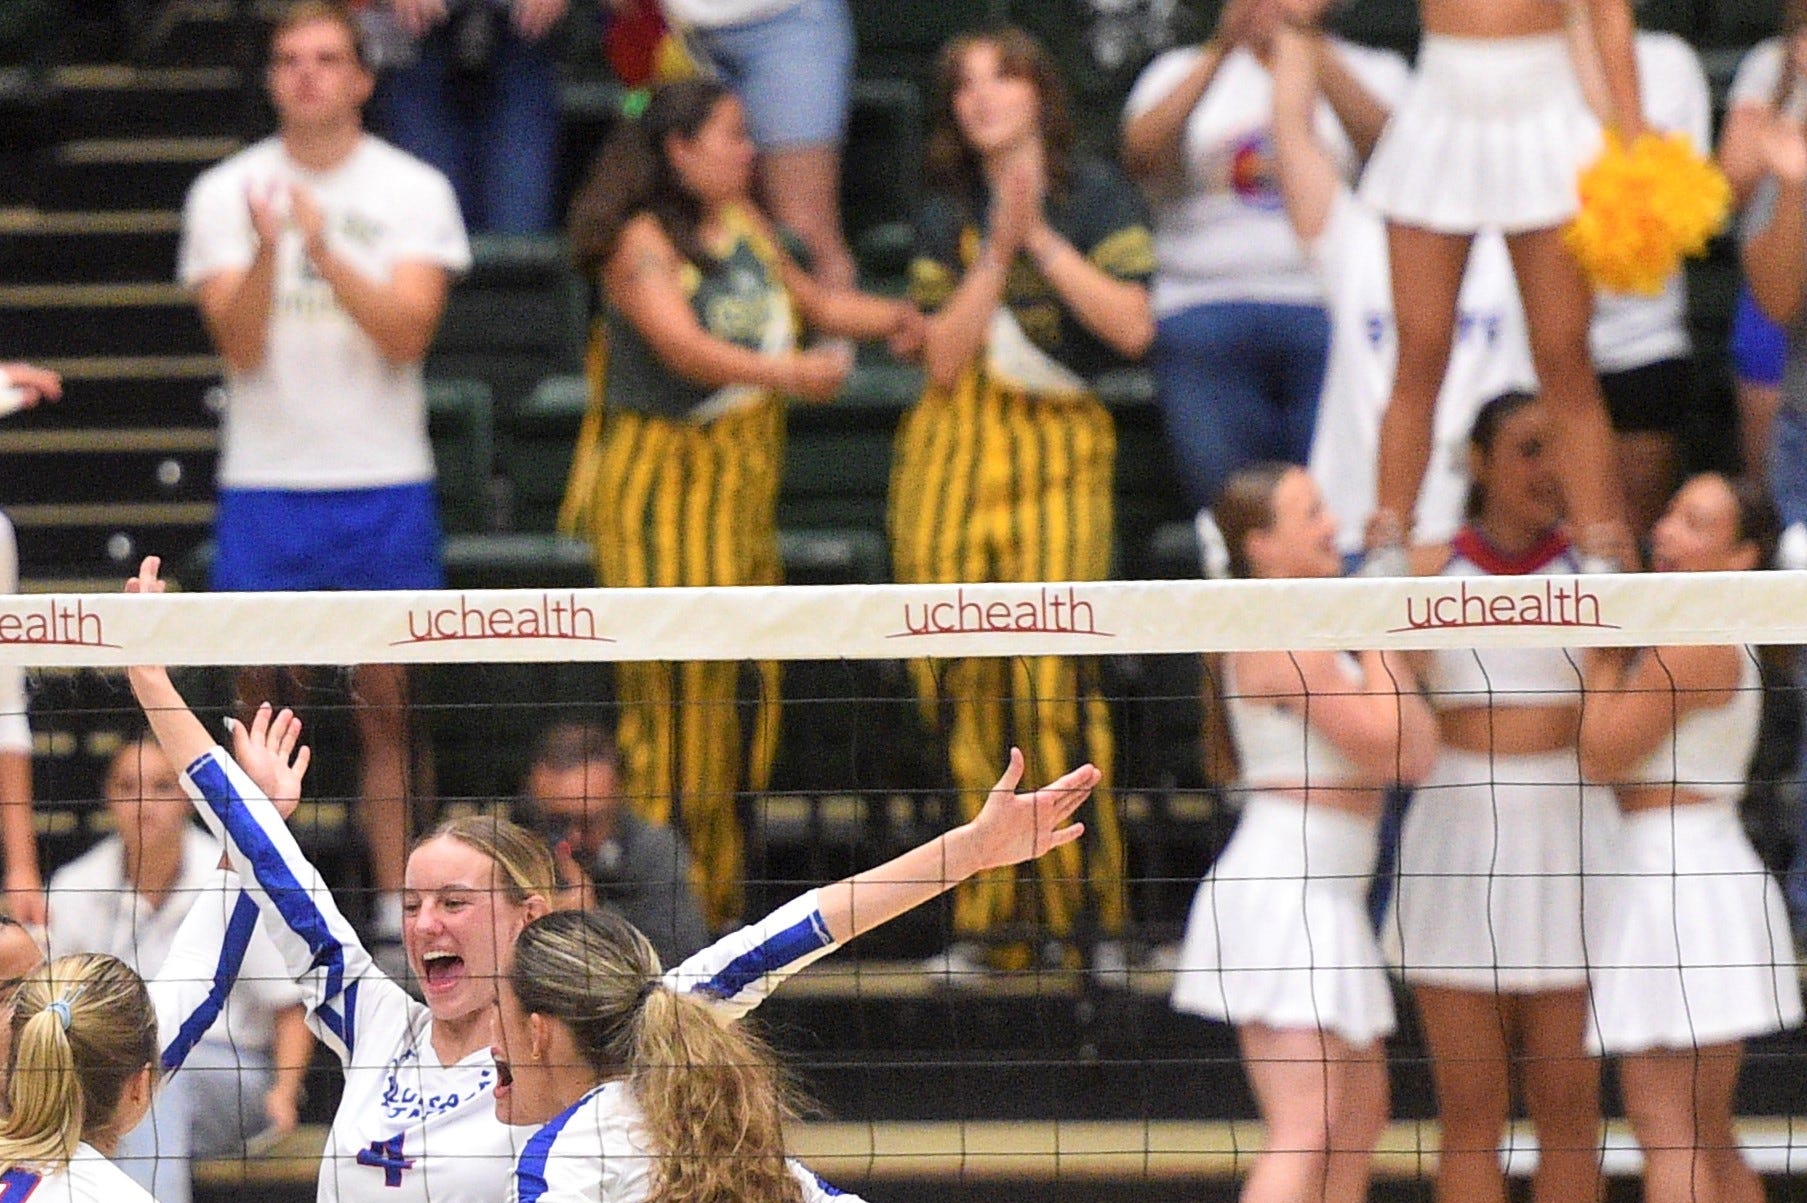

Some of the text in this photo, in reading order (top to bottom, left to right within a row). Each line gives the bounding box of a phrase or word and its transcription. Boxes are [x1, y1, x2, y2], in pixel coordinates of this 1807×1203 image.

[407, 595, 595, 641] uchealth
[904, 588, 1094, 635] uchealth
[1406, 581, 1599, 629] uchealth
[356, 1132, 416, 1187] 4
